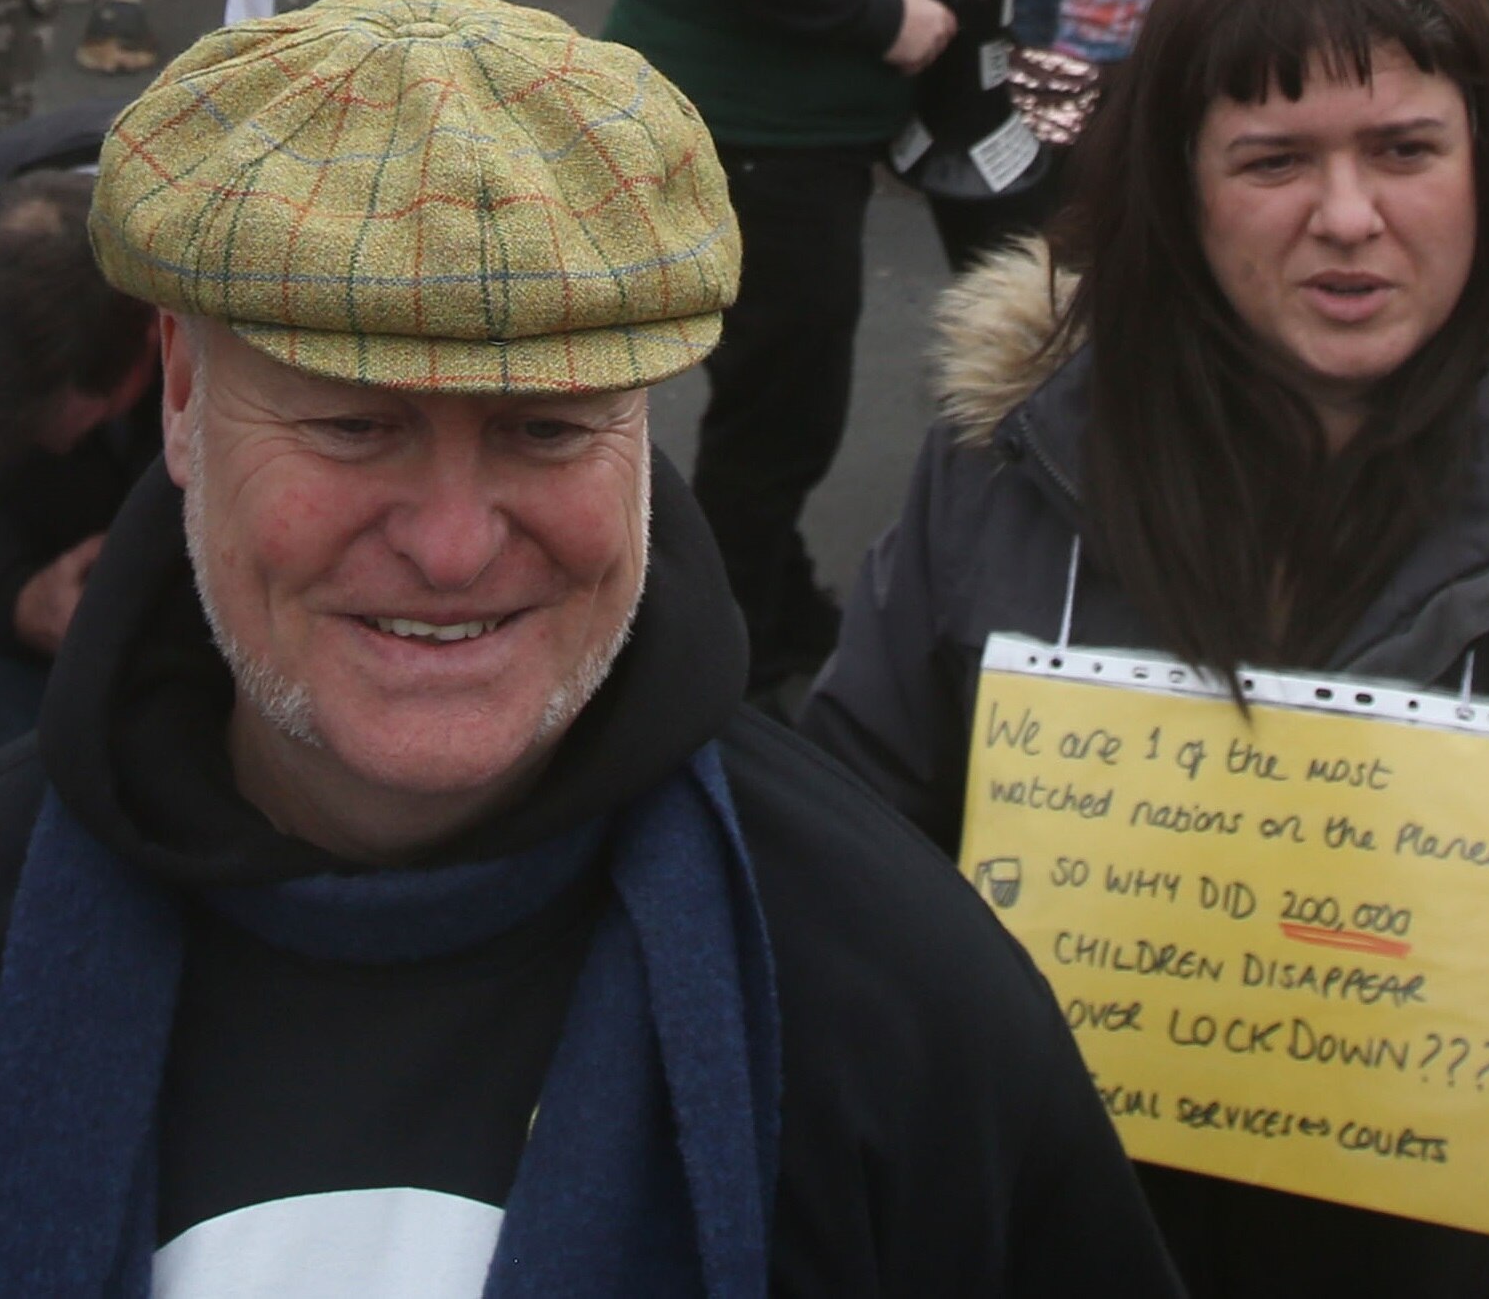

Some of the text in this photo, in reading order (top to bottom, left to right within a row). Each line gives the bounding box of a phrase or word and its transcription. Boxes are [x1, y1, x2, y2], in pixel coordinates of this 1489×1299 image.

[986, 702, 1041, 756] We
[1059, 728, 1122, 766] are
[1176, 737, 1208, 780] of
[1226, 737, 1288, 781] the
[1307, 757, 1392, 791] most
[990, 775, 1114, 819] watched
[1129, 800, 1245, 835] nations
[1259, 814, 1305, 844] on
[1323, 815, 1377, 849] the
[1104, 864, 1182, 903] WHY
[1198, 875, 1257, 920] DID
[1279, 889, 1412, 937] 200,000
[1054, 931, 1427, 1005] CHILDREN DISAPPEAR
[1067, 1000, 1143, 1032] OVER
[1089, 1072, 1448, 1165] OCIAL SERVICES COURTS
